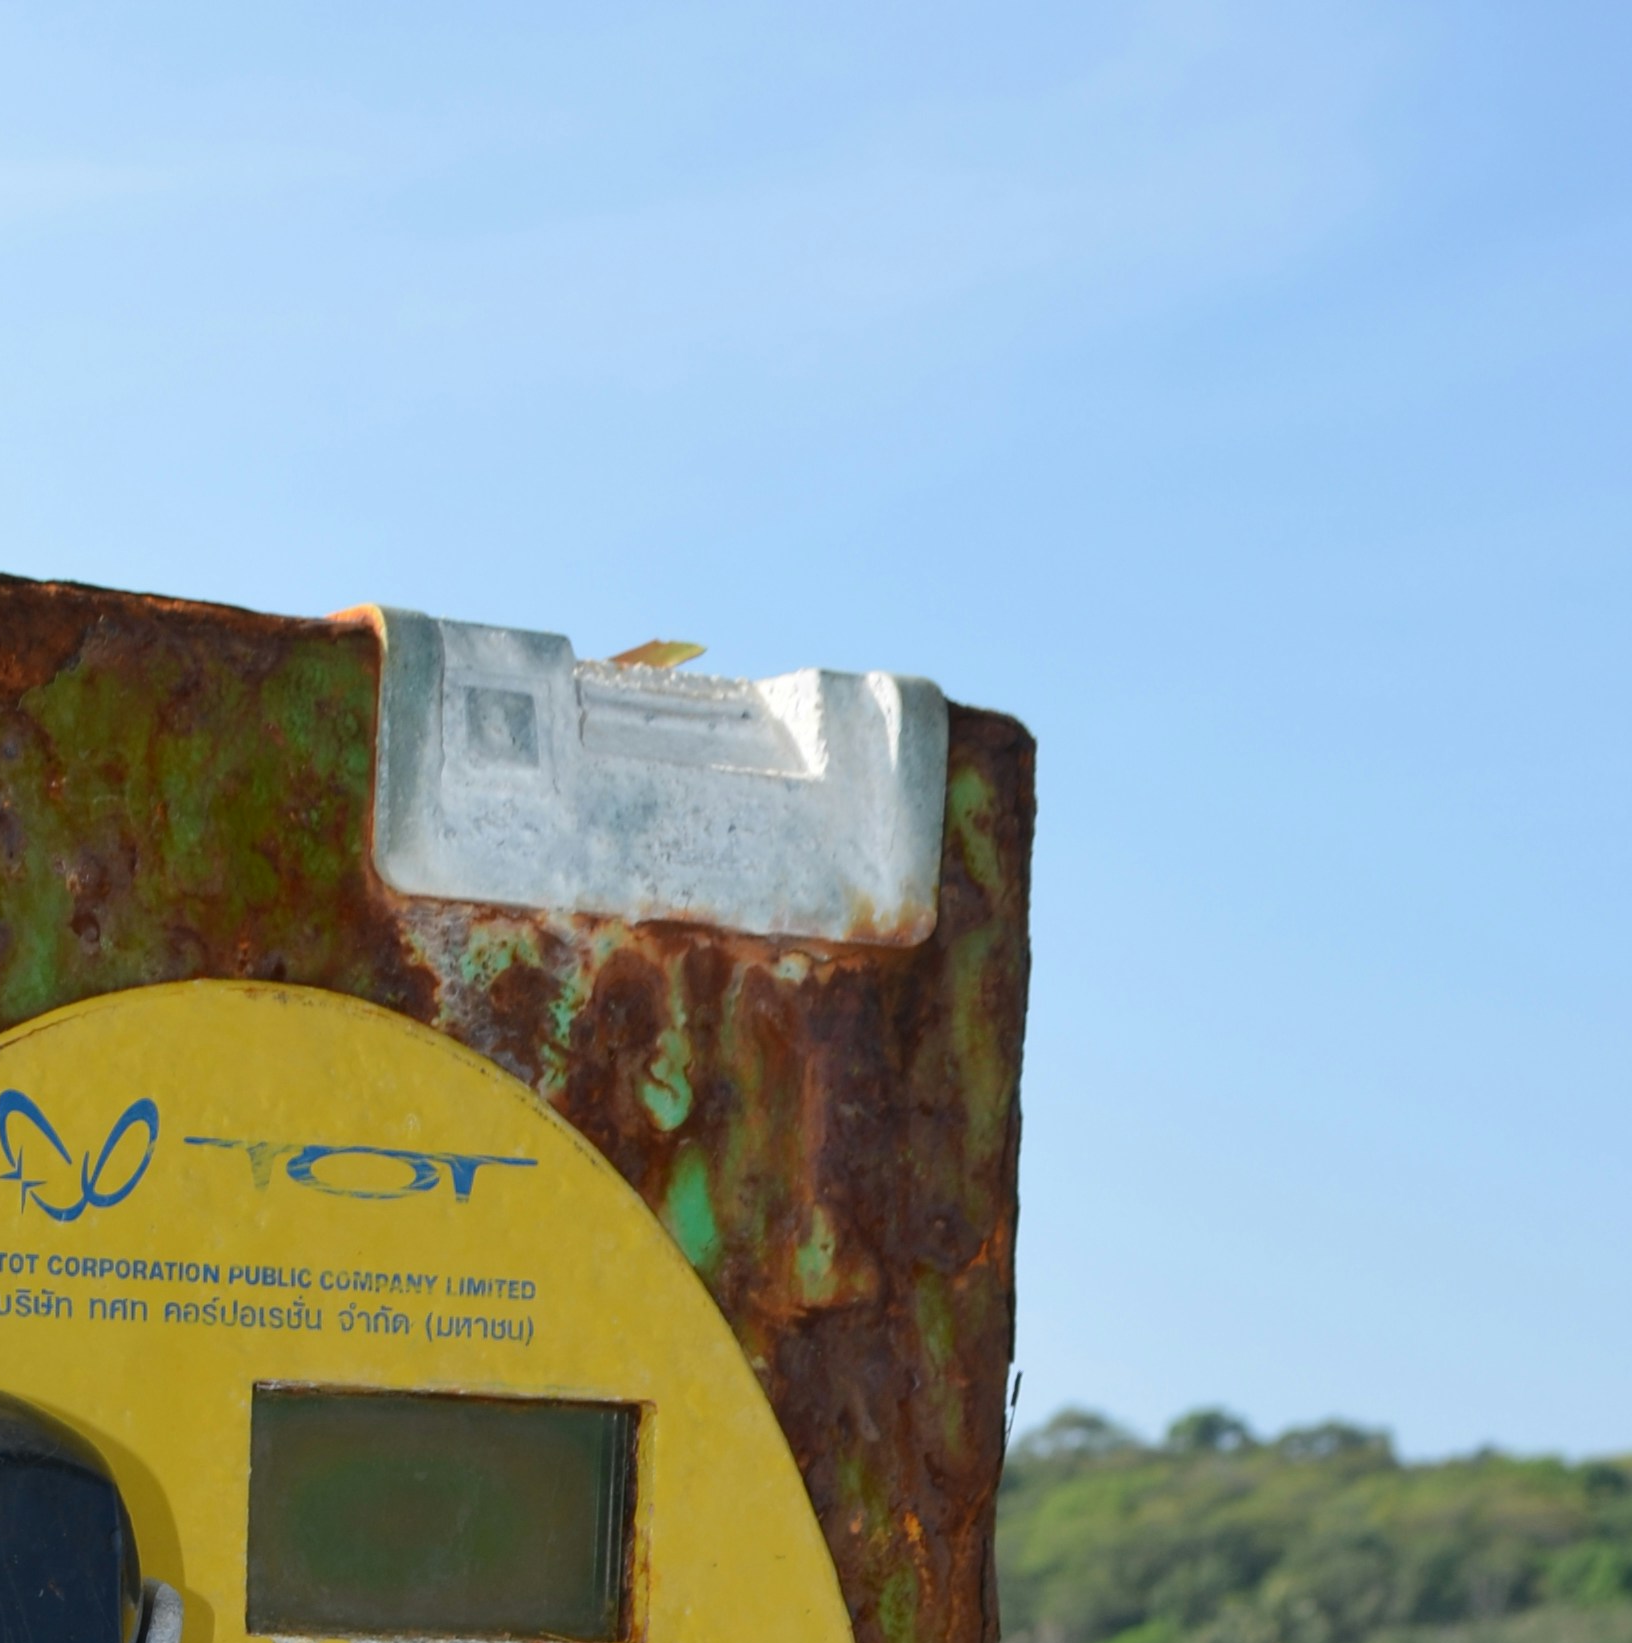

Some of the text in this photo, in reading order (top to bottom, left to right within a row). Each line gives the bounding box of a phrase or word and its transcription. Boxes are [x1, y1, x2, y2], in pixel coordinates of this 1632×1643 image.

[183, 1136, 539, 1203] TOT
[47, 1254, 219, 1284] CORPORATION
[229, 1264, 312, 1289] PUBLIC
[320, 1270, 438, 1295] COMPANY
[446, 1276, 536, 1300] LIMITED
[89, 1297, 148, 1322] ทศท
[164, 1295, 323, 1330] คอร์ปอเรชั่น
[338, 1302, 410, 1335] จำกัด
[425, 1311, 535, 1346] (มหาชน)
